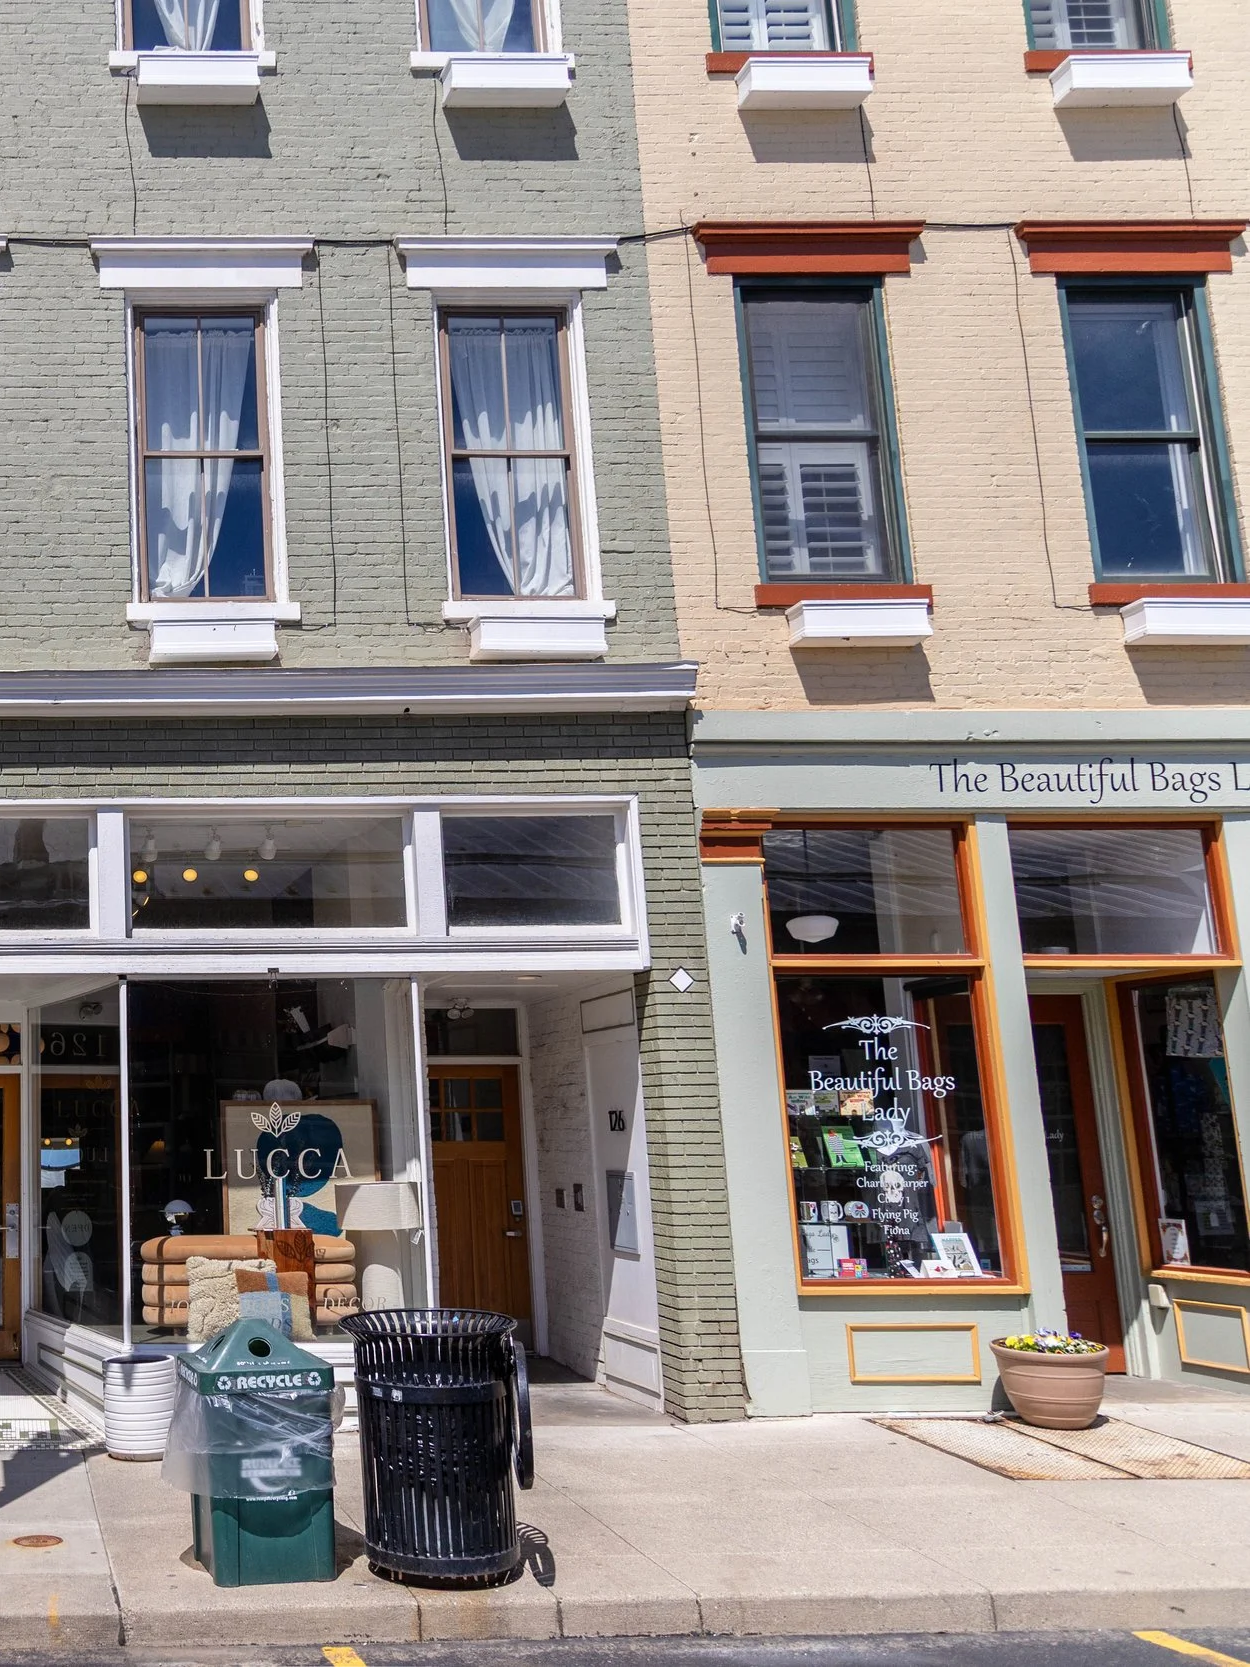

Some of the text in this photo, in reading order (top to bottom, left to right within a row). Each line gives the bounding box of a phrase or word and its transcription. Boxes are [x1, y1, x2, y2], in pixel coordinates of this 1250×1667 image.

[929, 757, 1250, 804] The Beautiful Bags L
[858, 1036, 898, 1061] The
[808, 1066, 901, 1099] Beautiful
[905, 1069, 956, 1099] Bags
[608, 1110, 626, 1132] 126
[861, 1098, 911, 1129] Lady
[203, 1148, 354, 1180] LUCCA
[864, 1161, 918, 1176] Featuring:
[872, 1208, 919, 1223] Flying Pig
[884, 1225, 911, 1235] Fiona
[323, 1296, 387, 1310] DECOR
[236, 1373, 302, 1390] RECYCLE
